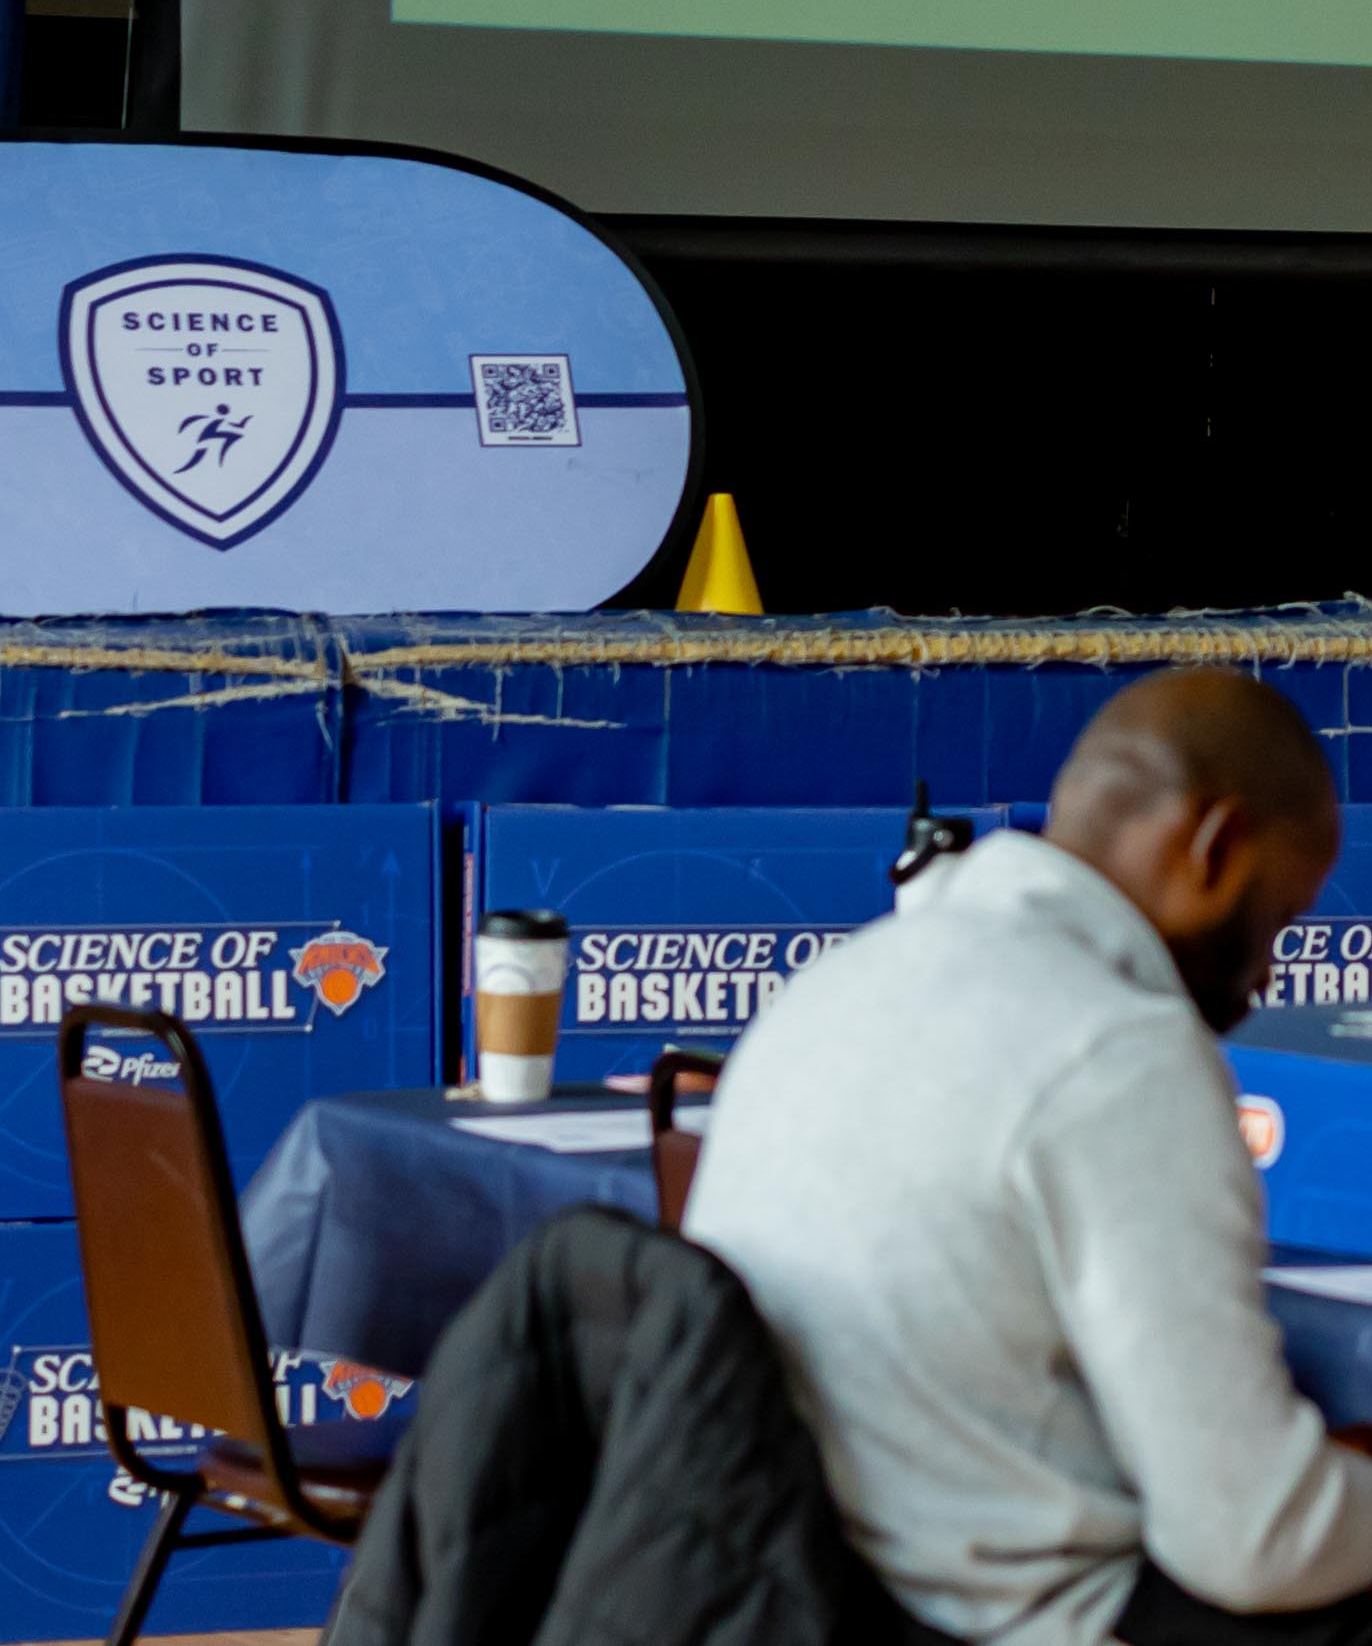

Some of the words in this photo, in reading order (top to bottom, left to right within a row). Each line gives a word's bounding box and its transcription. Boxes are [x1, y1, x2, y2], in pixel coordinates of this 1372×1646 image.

[122, 311, 280, 333] SCIENCE
[186, 343, 219, 357] OF
[147, 366, 265, 387] SPORT
[0, 931, 203, 973] SCIENCE
[211, 930, 278, 969] OF
[576, 932, 778, 972] SCIENCE
[576, 971, 788, 1022] BASKETB
